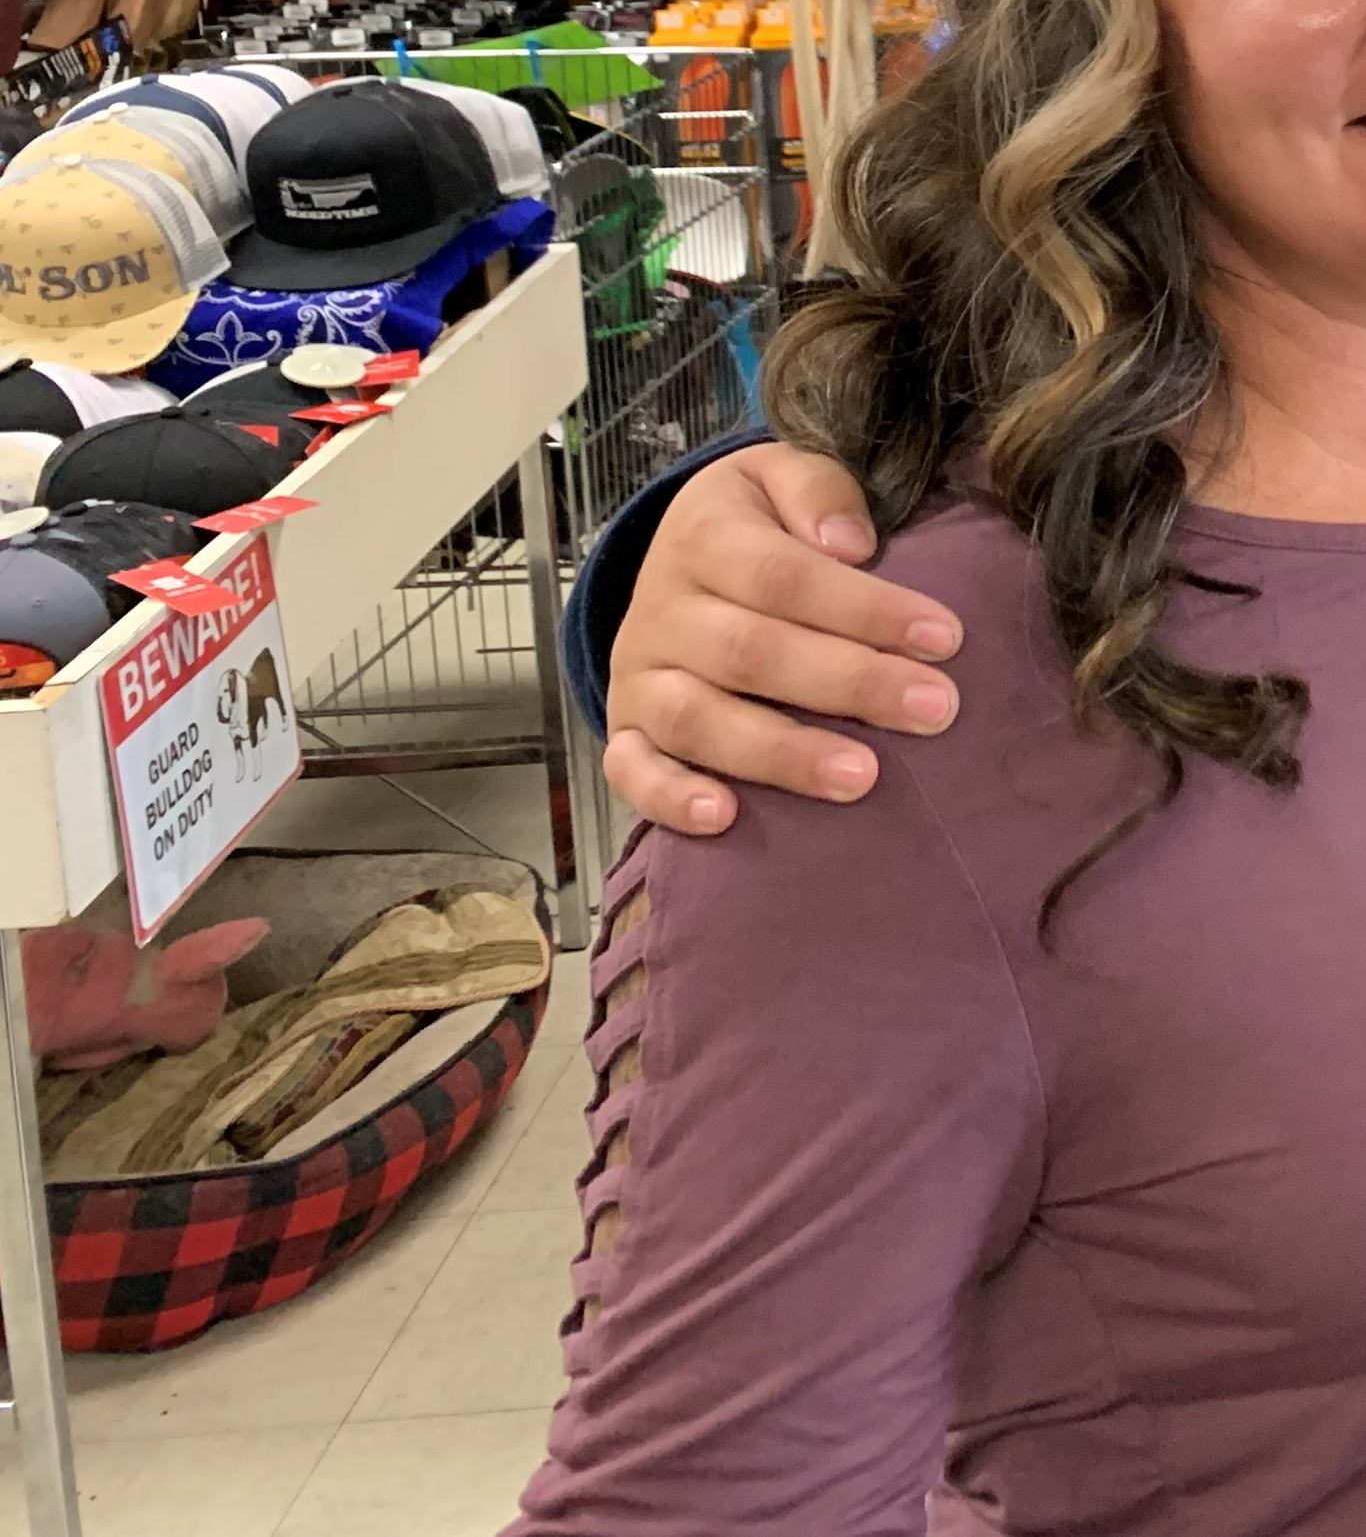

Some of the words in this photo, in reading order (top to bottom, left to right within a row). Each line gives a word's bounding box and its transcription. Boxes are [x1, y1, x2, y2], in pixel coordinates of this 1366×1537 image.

[145, 749, 213, 831] BULLDOG
[148, 722, 200, 785] GUARD
[154, 825, 176, 863] ON
[178, 782, 215, 839] DUTY
